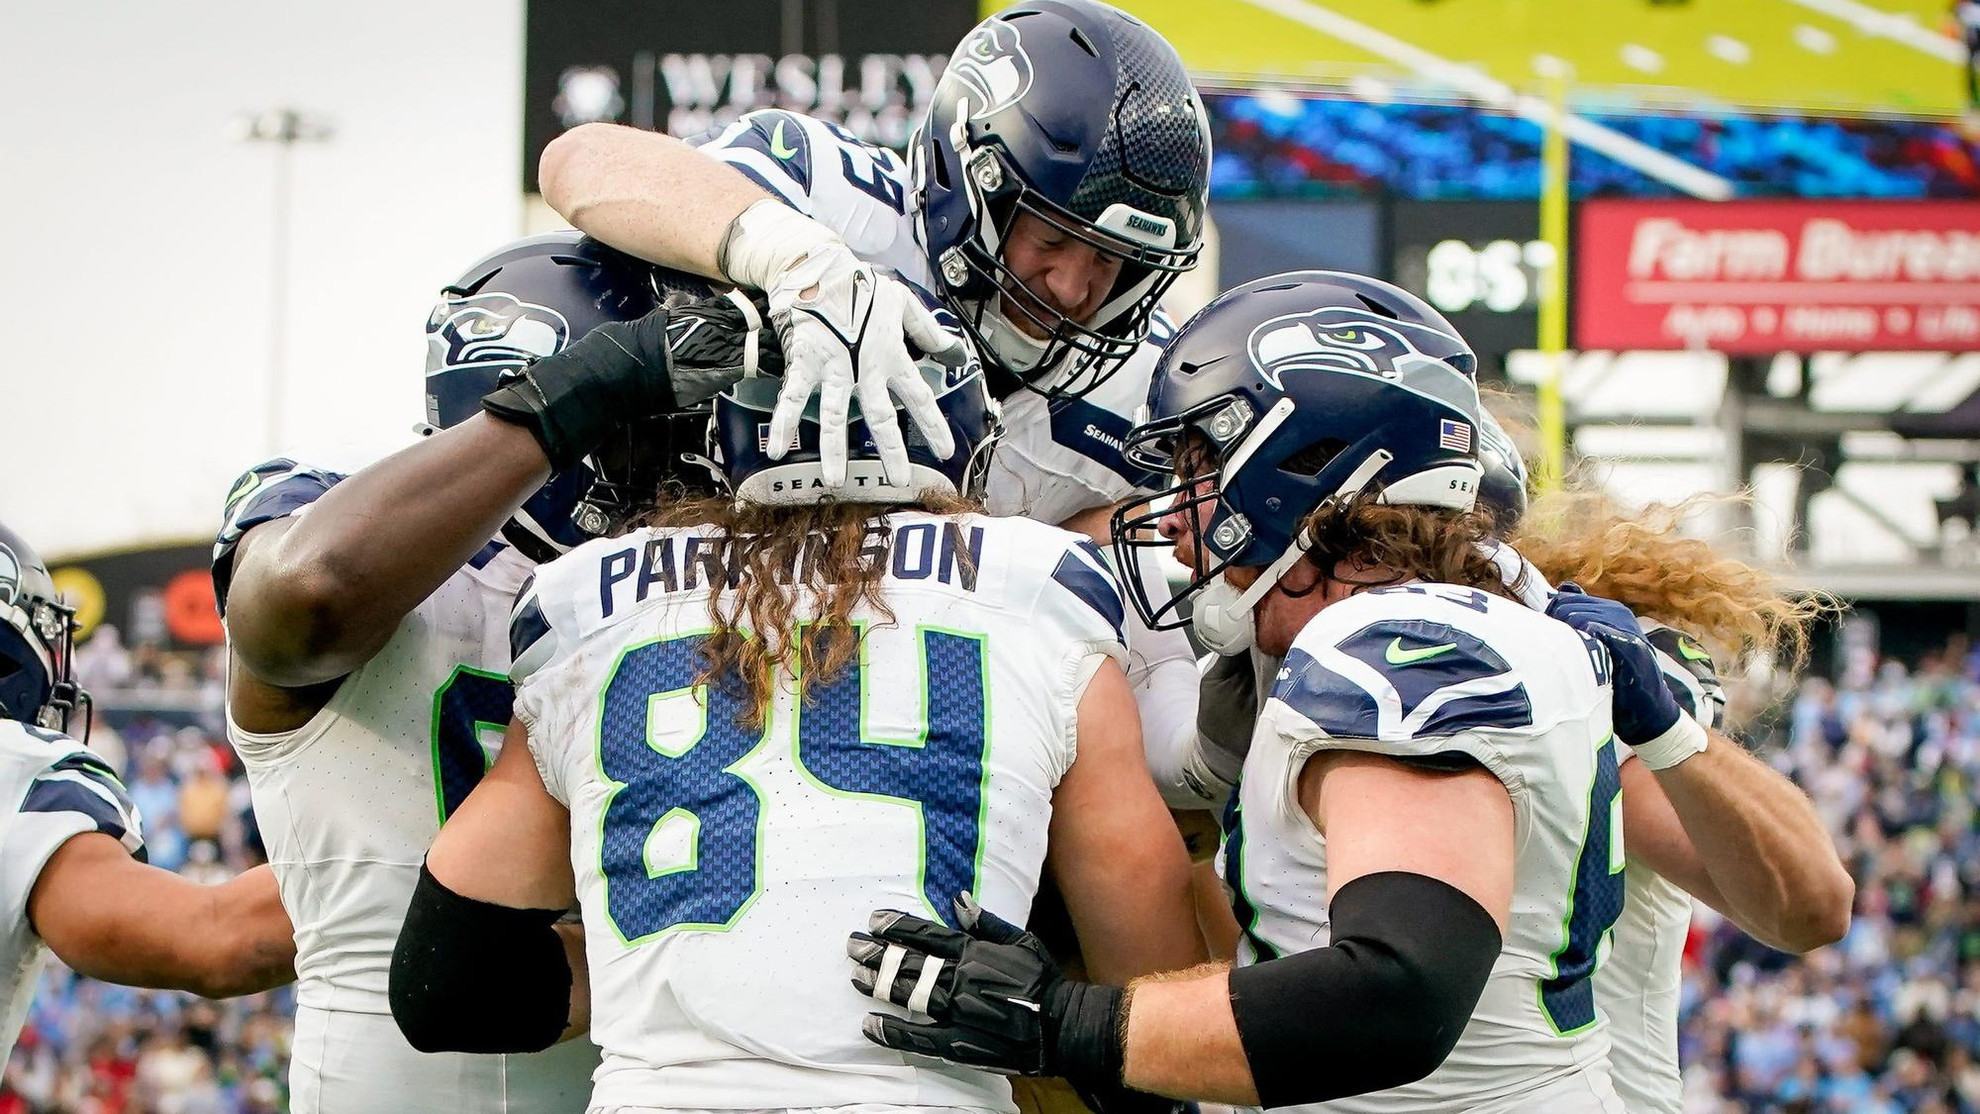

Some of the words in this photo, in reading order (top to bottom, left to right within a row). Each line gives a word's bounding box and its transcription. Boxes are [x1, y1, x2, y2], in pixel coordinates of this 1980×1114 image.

[1126, 214, 1168, 237] SEAHAWKS
[1628, 216, 1788, 280] Farm
[773, 476, 910, 492] SEATL
[595, 619, 990, 948] 84
